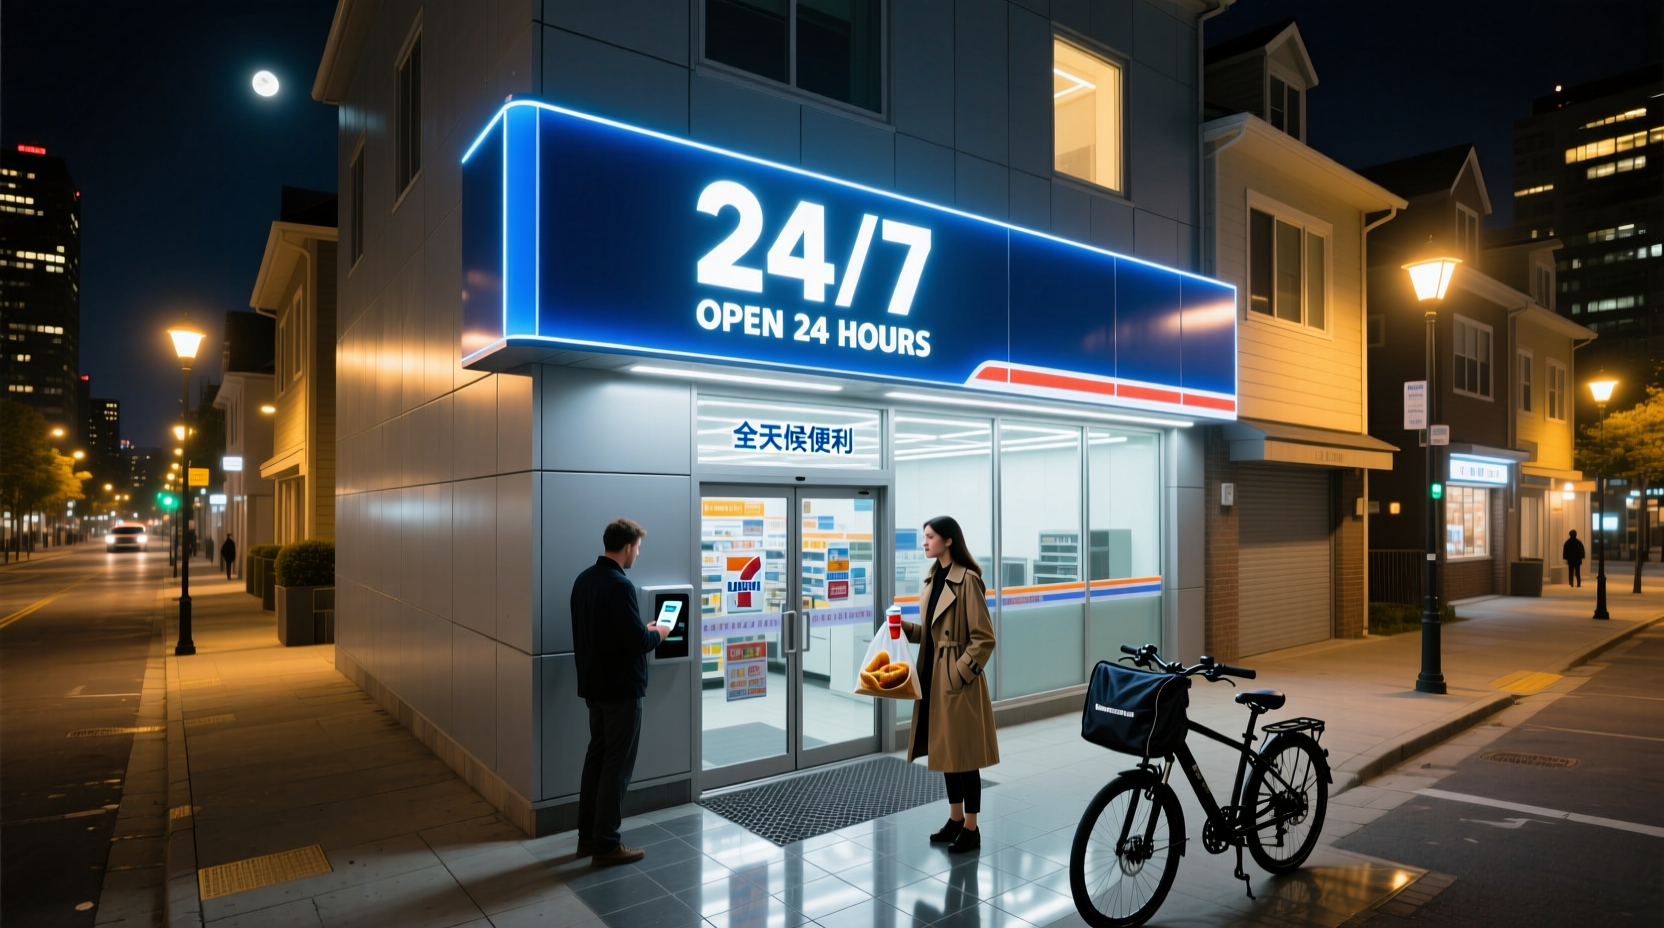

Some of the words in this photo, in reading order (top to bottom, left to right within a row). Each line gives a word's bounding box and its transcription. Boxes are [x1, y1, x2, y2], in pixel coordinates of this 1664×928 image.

[696, 180, 932, 316] 24/7
[696, 298, 784, 339] OPEN
[793, 313, 830, 345] 24
[838, 319, 931, 358] HOURS
[733, 420, 854, 454] 全天候便利
